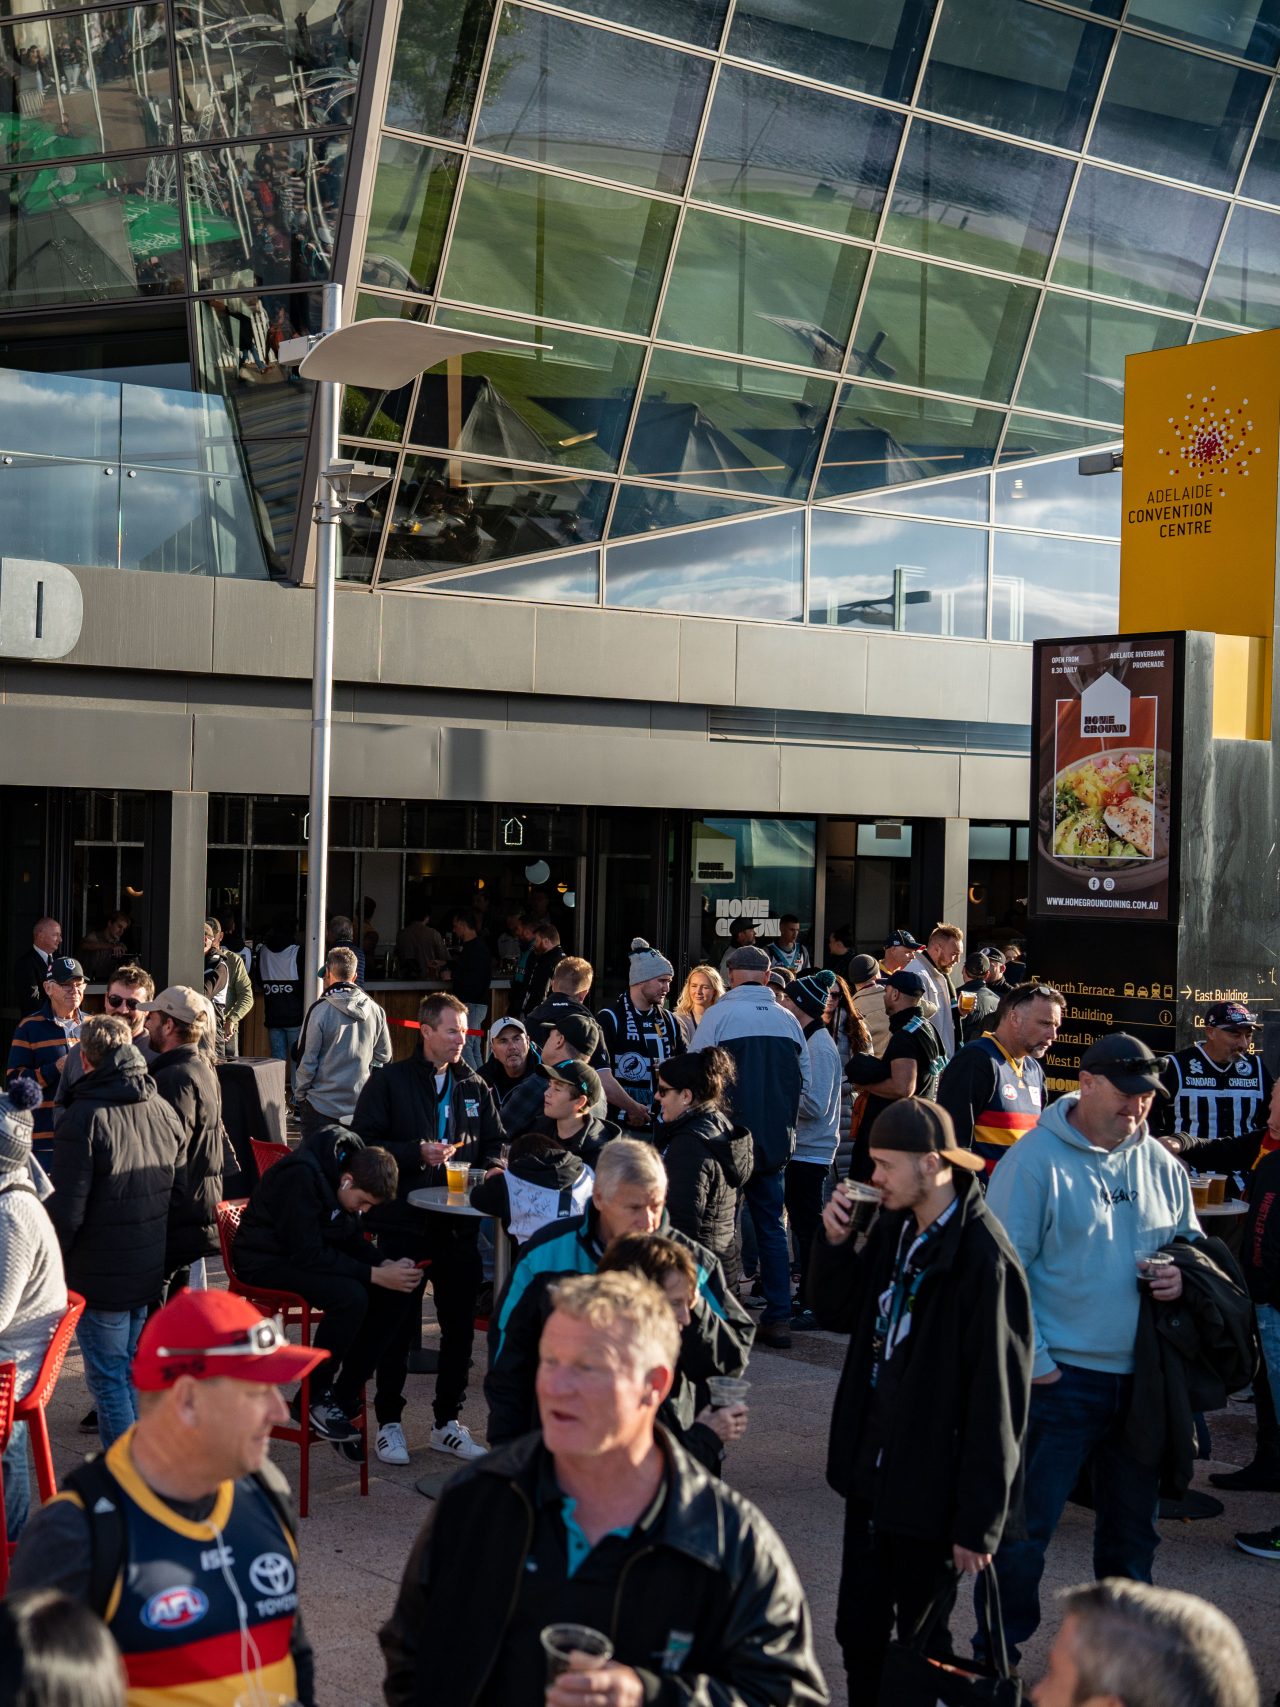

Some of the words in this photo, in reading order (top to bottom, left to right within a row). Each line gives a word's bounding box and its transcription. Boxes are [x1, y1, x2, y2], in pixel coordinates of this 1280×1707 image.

[1147, 484, 1213, 504] ADELAIDE
[1128, 502, 1213, 524] CONVENTION
[1159, 520, 1212, 538] CENTRE
[1132, 661, 1165, 669] PROMENADE
[1084, 716, 1115, 724] HOME
[1084, 724, 1127, 733] GROUND
[715, 899, 770, 918] HOME
[1046, 897, 1159, 910] WWW.HOMEGROUNDDINING.COM.AU
[715, 918, 781, 937] GUN
[1047, 980, 1076, 993] North
[1078, 982, 1115, 996] Terrace
[1194, 989, 1214, 1001] East
[1215, 988, 1248, 1004] Building
[1071, 1006, 1113, 1025] Building
[1046, 1053, 1071, 1067] West
[149, 1593, 202, 1622] AFL
